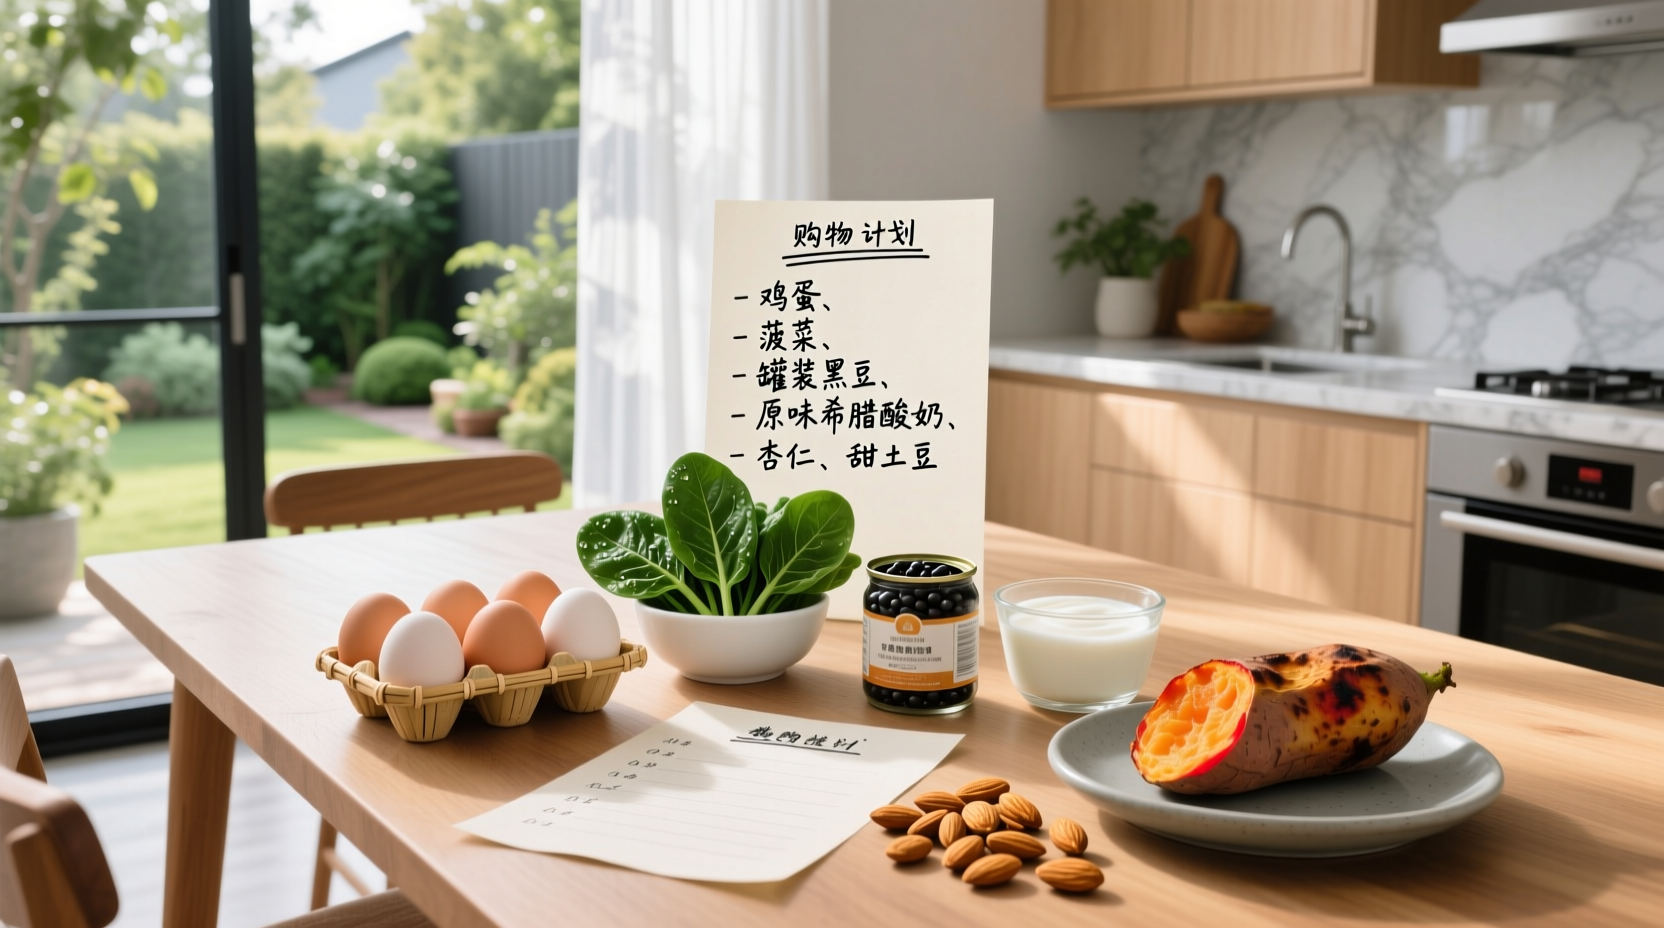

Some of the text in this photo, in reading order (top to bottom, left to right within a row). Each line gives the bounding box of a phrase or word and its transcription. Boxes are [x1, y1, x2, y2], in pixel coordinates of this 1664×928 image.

[759, 279, 831, 312] 鸡蛋、
[759, 317, 830, 352] 菠菜、
[755, 356, 888, 393] 罐装黑豆、
[755, 396, 955, 435] 原味希腊酸奶、
